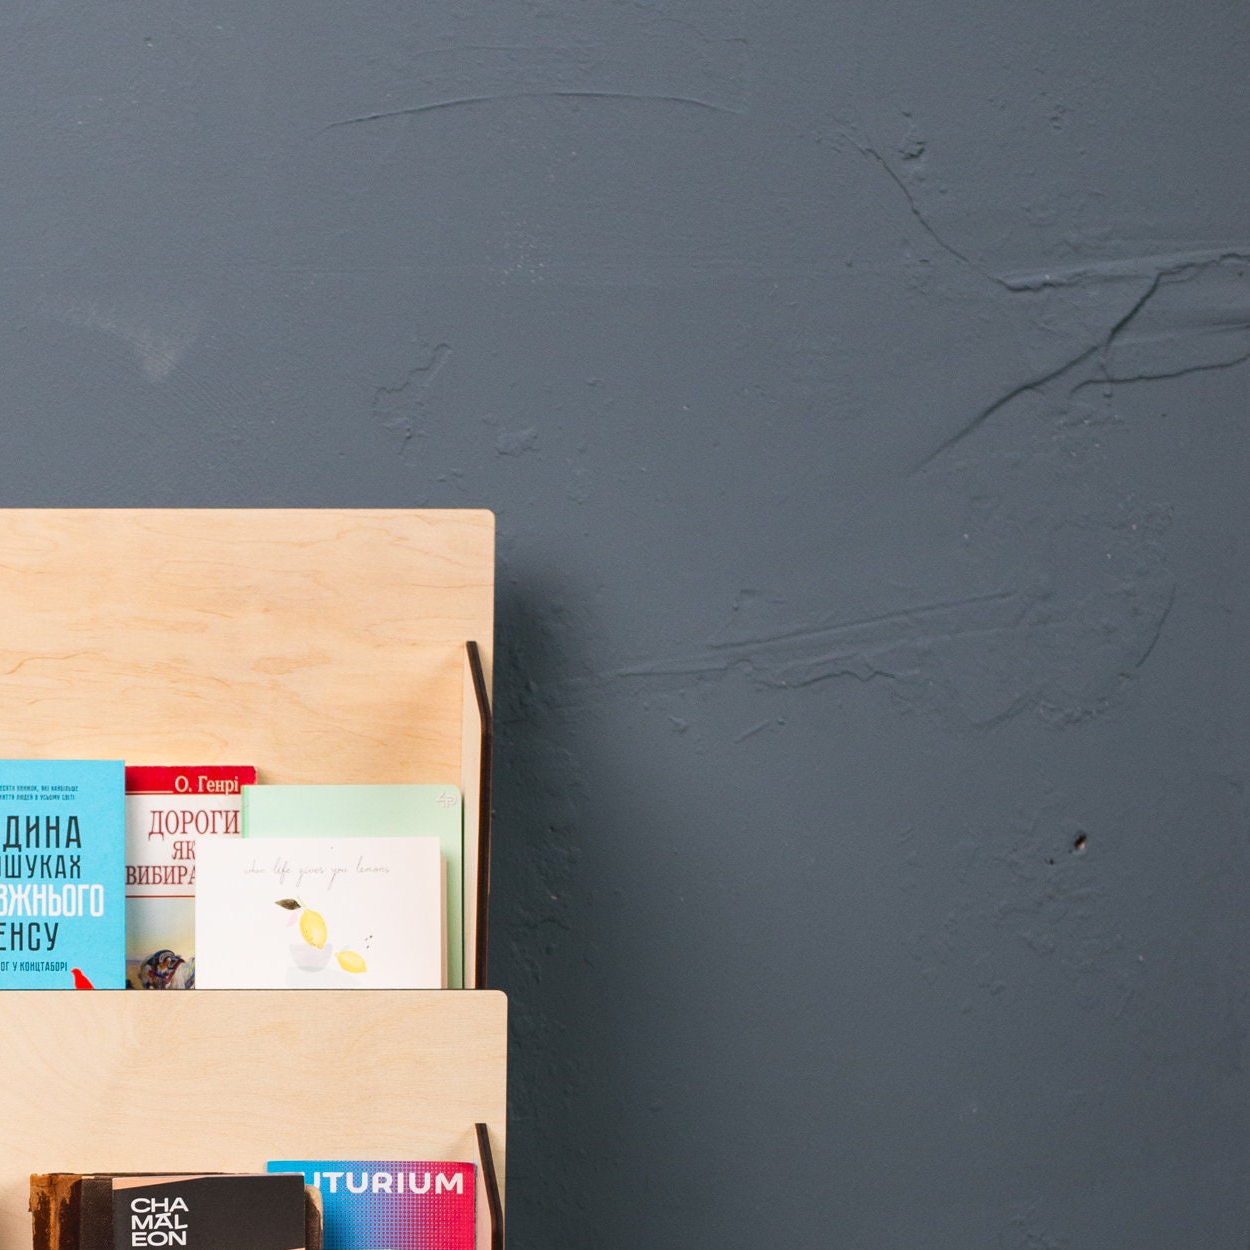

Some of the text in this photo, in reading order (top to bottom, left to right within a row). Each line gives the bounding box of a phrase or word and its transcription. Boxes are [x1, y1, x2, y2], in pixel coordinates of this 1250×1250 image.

[198, 776, 239, 795] Генрі
[148, 810, 240, 840] ДОРОГИ
[12, 961, 18, 972] У
[20, 961, 68, 972] КОНЦТАБОРІ
[302, 1171, 463, 1194] TURIUM
[130, 1197, 189, 1213] CHA
[132, 1230, 186, 1247] EON
